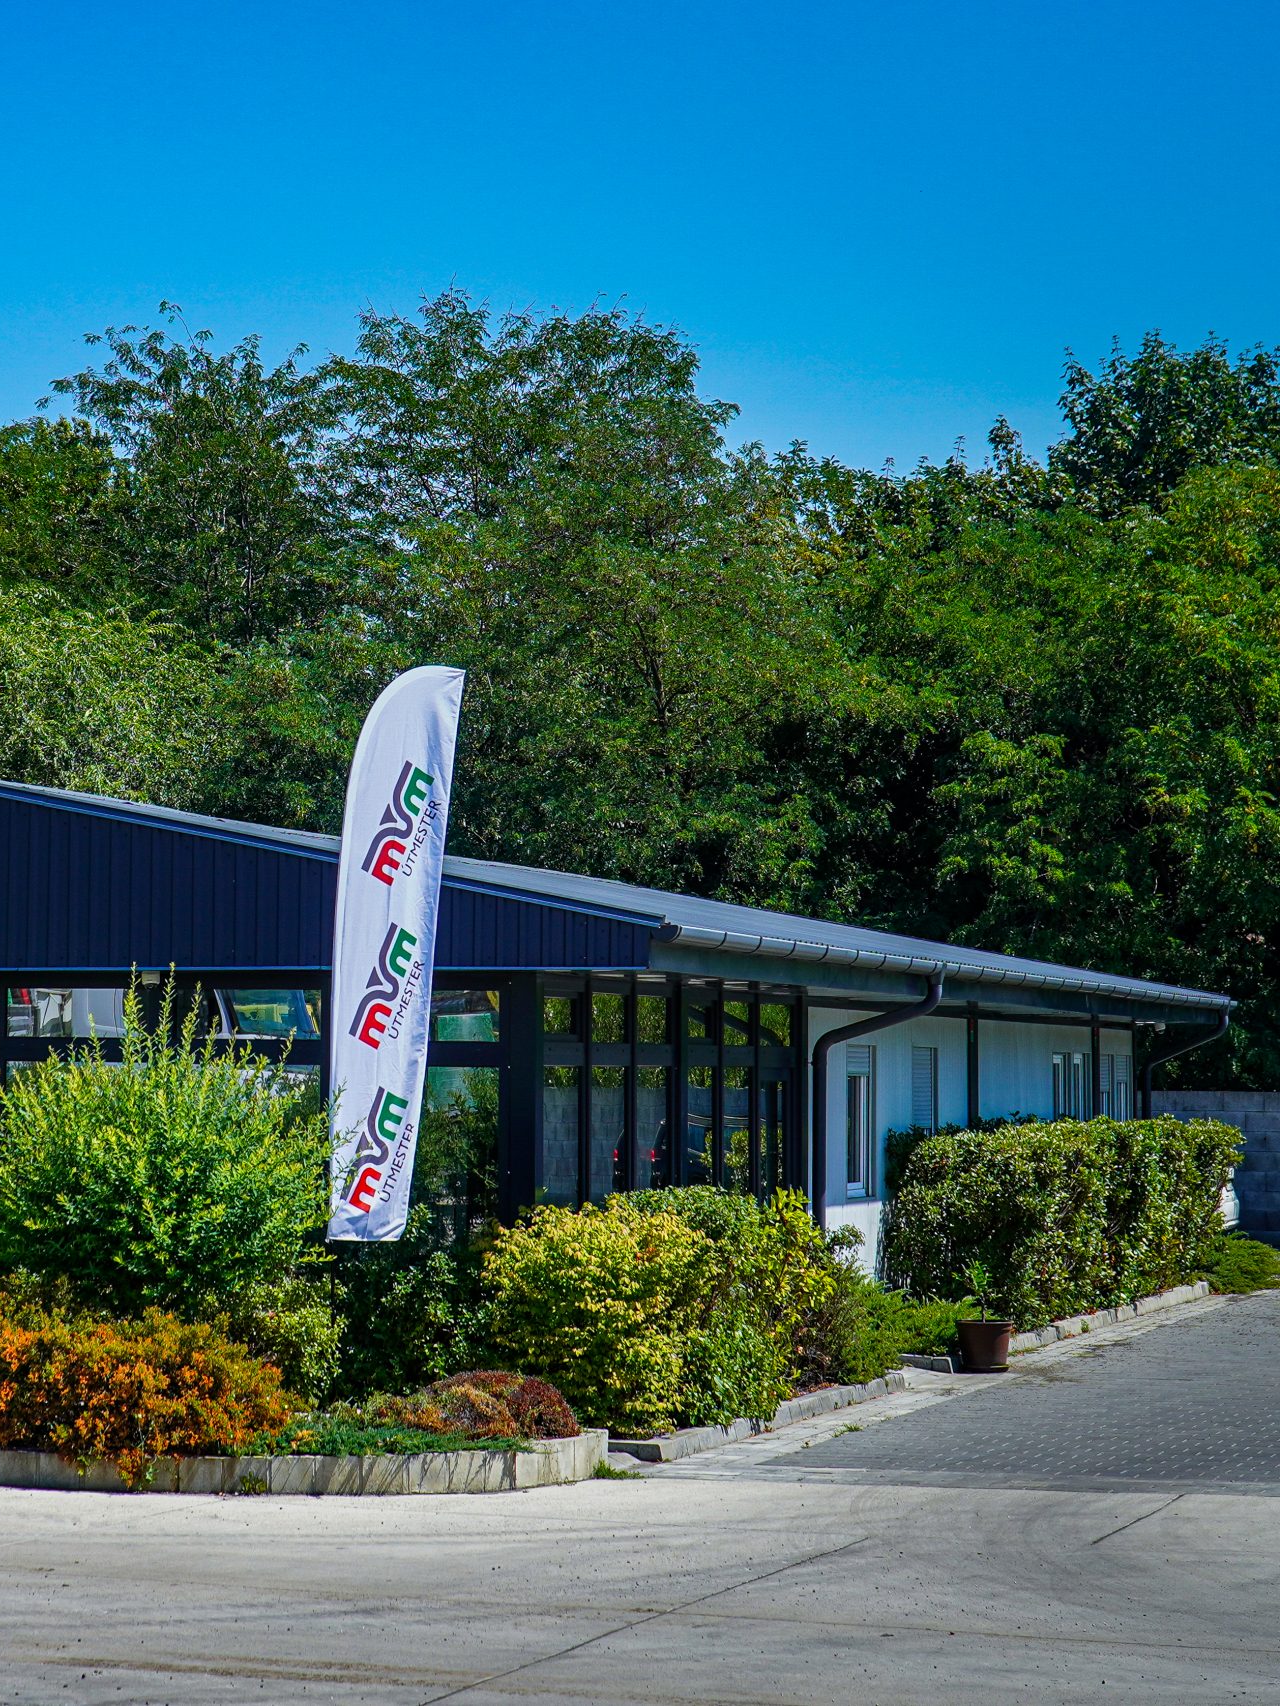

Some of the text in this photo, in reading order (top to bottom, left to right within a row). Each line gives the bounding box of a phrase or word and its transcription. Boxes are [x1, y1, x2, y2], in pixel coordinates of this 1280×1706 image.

[402, 799, 442, 877] ÚTMESTER
[388, 960, 425, 1040] ÚTMESTER
[378, 1123, 415, 1203] ÚTMESTER
